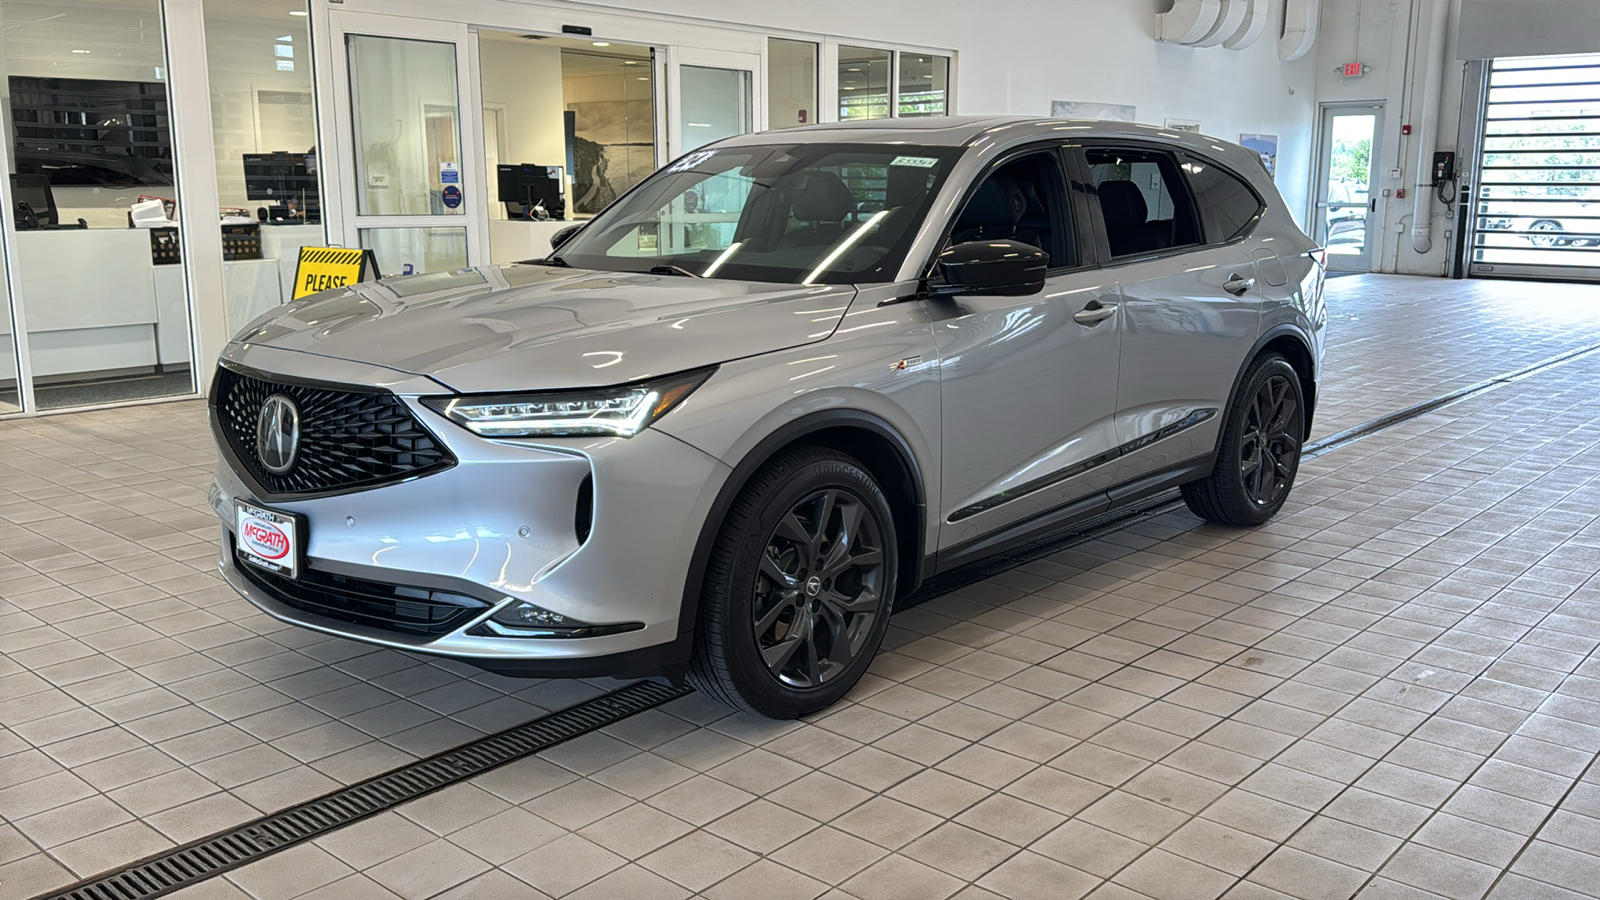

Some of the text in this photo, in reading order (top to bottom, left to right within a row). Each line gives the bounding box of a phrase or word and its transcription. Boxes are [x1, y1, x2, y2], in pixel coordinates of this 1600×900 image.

[1345, 62, 1360, 76] EXIT
[304, 273, 347, 292] PLEASE
[813, 463, 883, 499] BRIDGESTONE
[268, 545, 279, 553] Group
